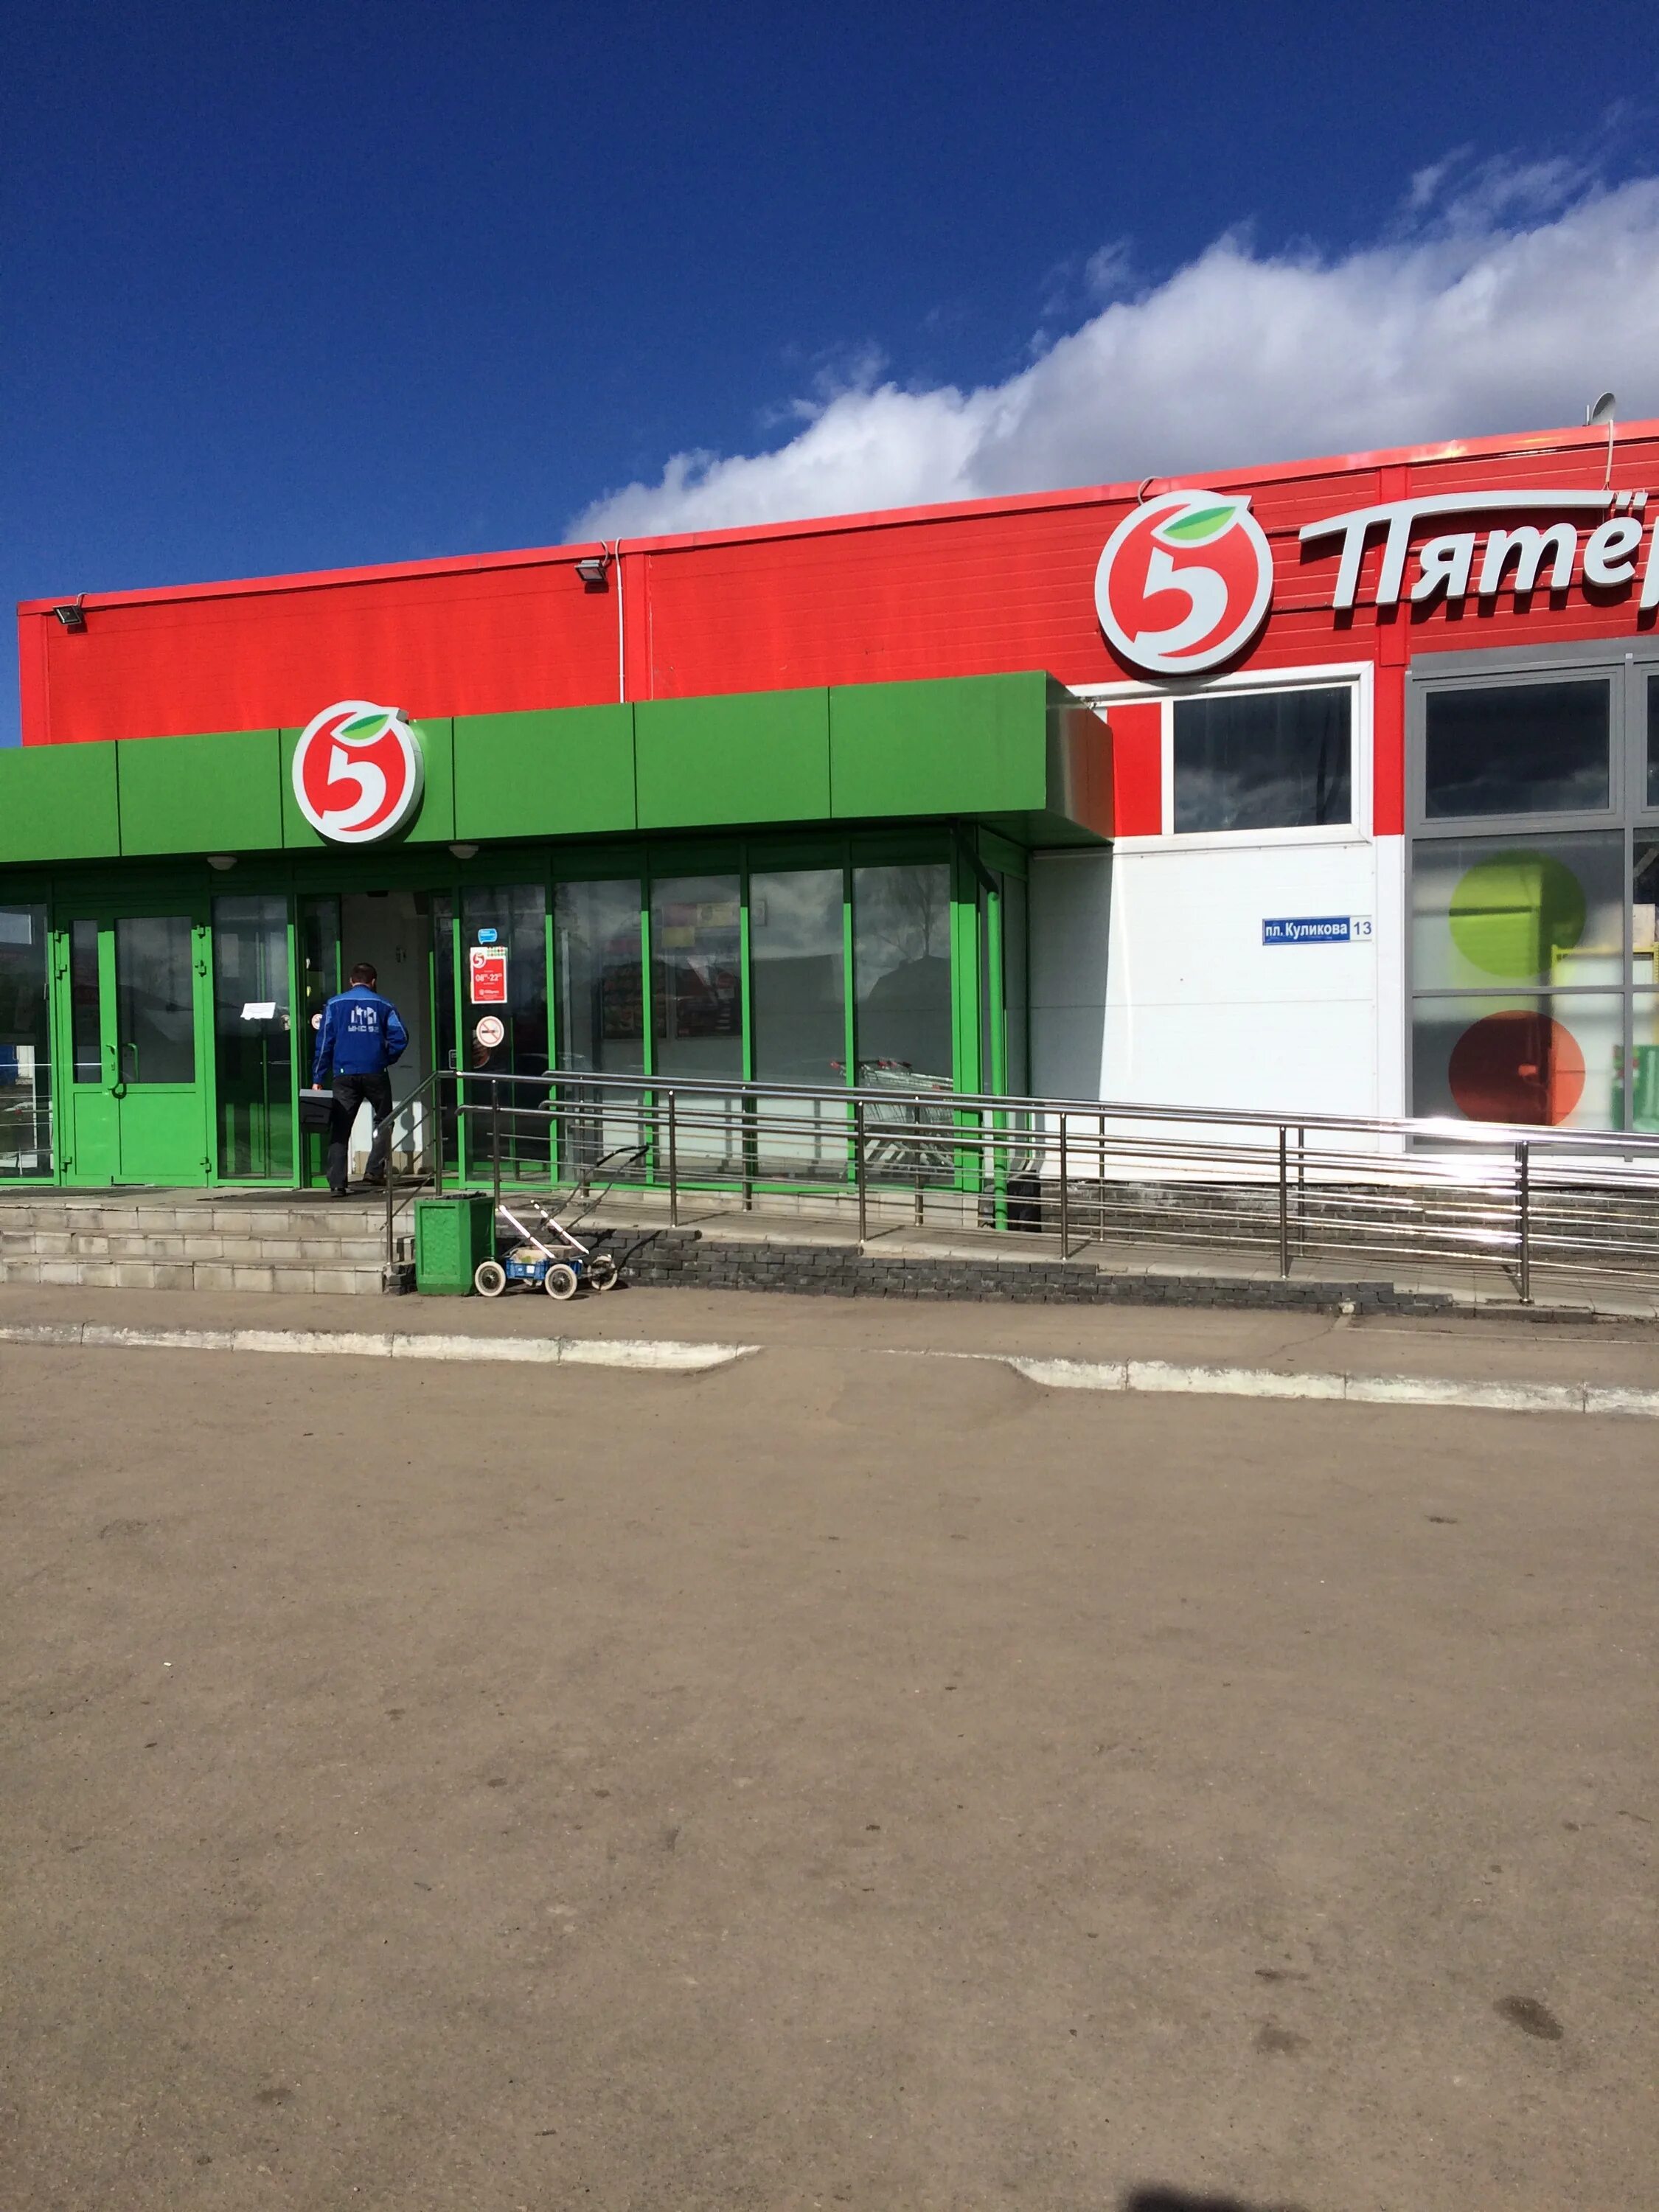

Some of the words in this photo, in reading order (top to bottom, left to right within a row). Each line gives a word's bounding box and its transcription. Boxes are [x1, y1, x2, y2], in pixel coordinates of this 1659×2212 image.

[1265, 925, 1283, 936] пл.
[1285, 922, 1348, 940] Куликова
[1353, 922, 1372, 935] 13
